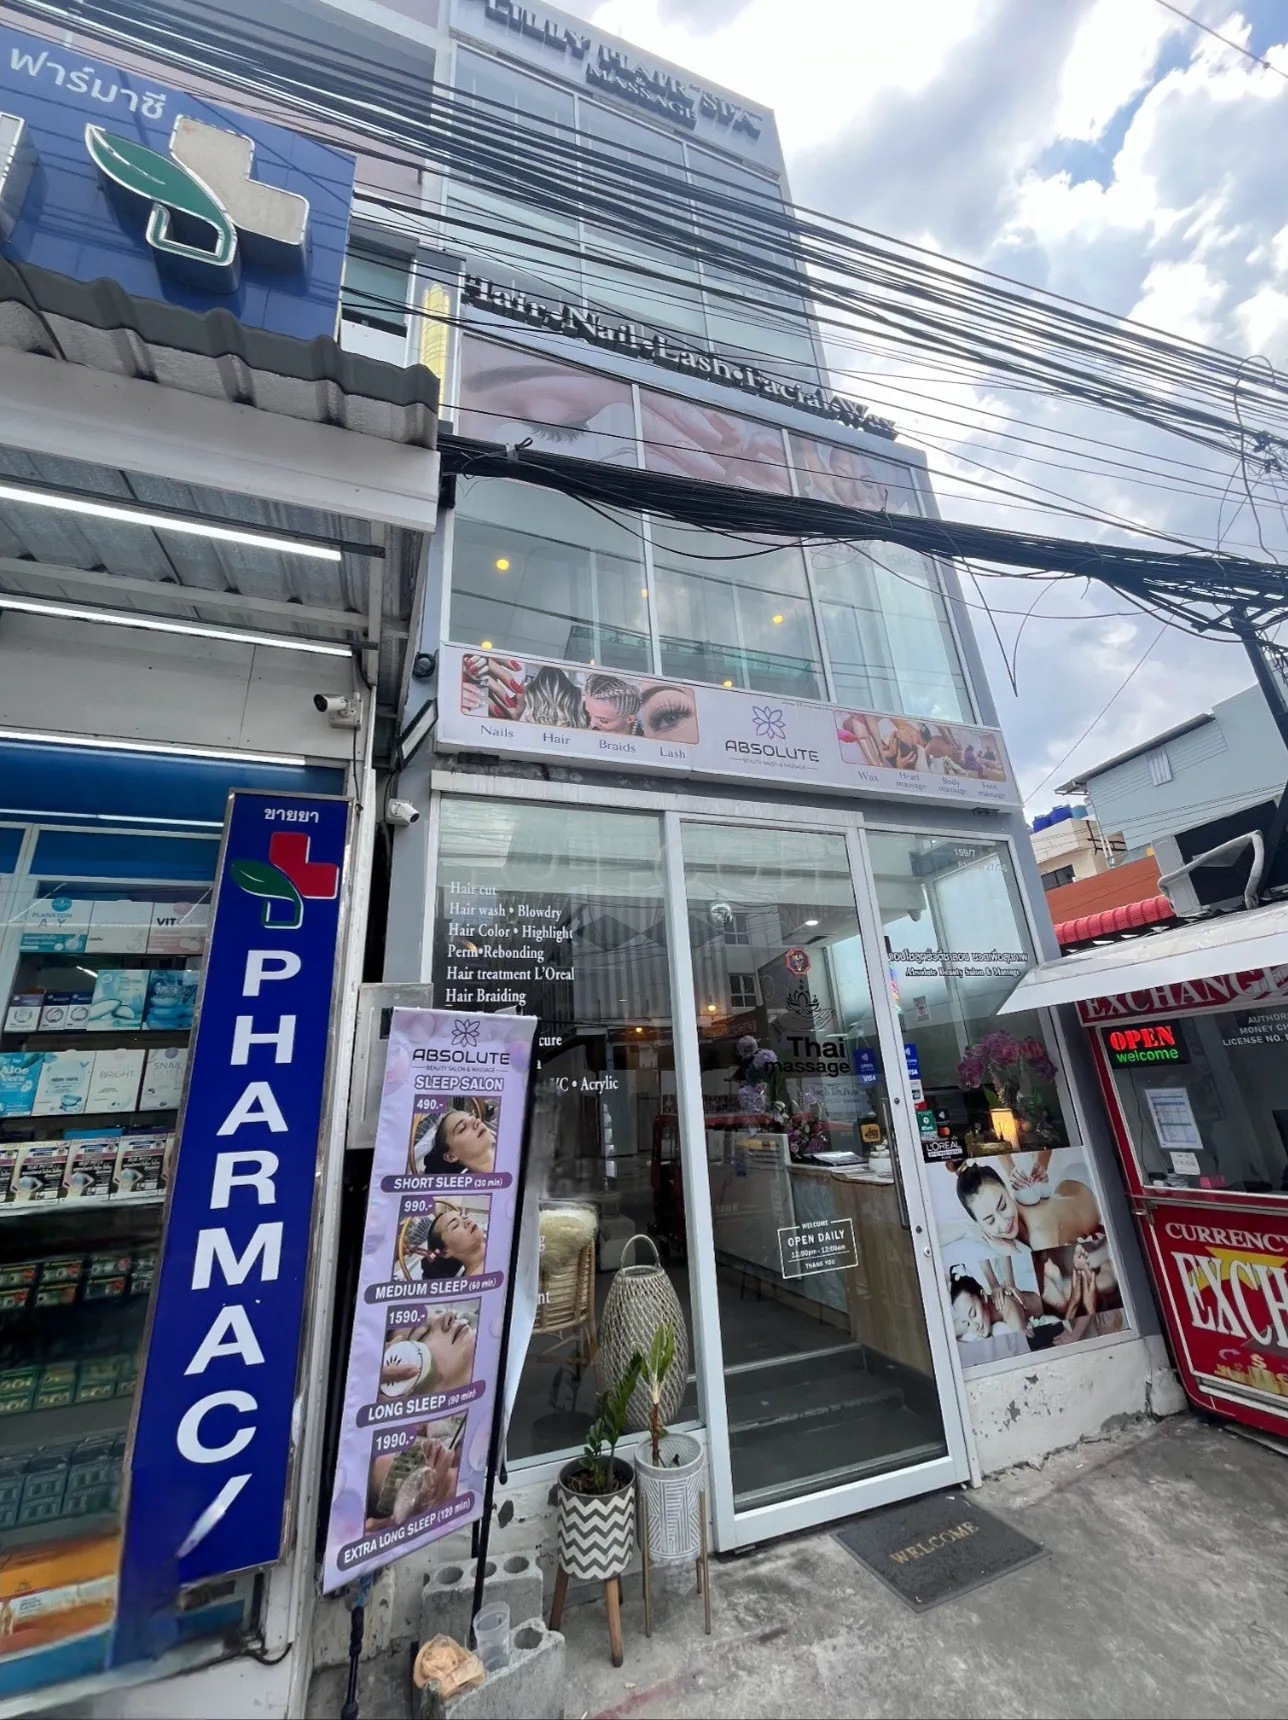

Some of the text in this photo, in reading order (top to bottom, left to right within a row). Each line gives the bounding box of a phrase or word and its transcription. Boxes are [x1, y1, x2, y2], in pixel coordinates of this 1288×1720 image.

[586, 63, 697, 128] MASSAGE
[462, 276, 547, 325] Hair
[564, 304, 642, 354] Nail
[653, 336, 733, 386] Lash
[480, 725, 514, 739] Nails
[543, 733, 571, 746] Hair
[599, 739, 636, 754] Braids
[659, 747, 686, 760] Lash
[725, 740, 820, 763] ABSOLUTE
[857, 771, 879, 783] Wax
[899, 772, 921, 781] Head
[942, 776, 960, 788] Body
[896, 780, 927, 791] massage
[264, 808, 320, 823] ขายยา
[450, 881, 497, 896] Hair cut
[449, 902, 563, 922] Hair wash Blowdry
[156, 917, 177, 926] VIT
[448, 923, 574, 943] Hair Color Highlight
[446, 966, 575, 981] Hair treatment L'Oreal
[445, 988, 526, 1006] Hair Braiding
[1239, 1024, 1273, 1035] MONEY
[1109, 1025, 1176, 1051] OPEN
[1222, 1036, 1264, 1046] LICENSE
[1265, 1034, 1283, 1043] NO.
[786, 1036, 846, 1058] Thai
[412, 1048, 510, 1065] ABSOLUTE
[1116, 1048, 1179, 1063] welcome
[1, 1066, 29, 1075] Aloe
[764, 1060, 850, 1078] massage
[415, 1075, 504, 1092] SLEEP SALON
[580, 1075, 619, 1094] Acrylic
[416, 1099, 444, 1110] 490.-
[393, 1176, 503, 1190] SHORT SLEEP (30 min)
[404, 1200, 433, 1213] 990.-
[801, 1220, 829, 1229] WELCOME
[787, 1229, 845, 1247] OPEN DAILY
[805, 1261, 823, 1269] THANK
[375, 1277, 497, 1300] MEDIUM SLEEP (60 min)
[388, 1309, 426, 1325] 1590.-
[367, 1402, 404, 1421] LONG
[406, 1395, 446, 1413] SLEEP
[460, 1388, 477, 1402] min)
[376, 1431, 415, 1450] 1990.-
[343, 1497, 471, 1564] EXTRA LONG SLEEP (120 min)
[889, 1521, 979, 1564] WELCOME
